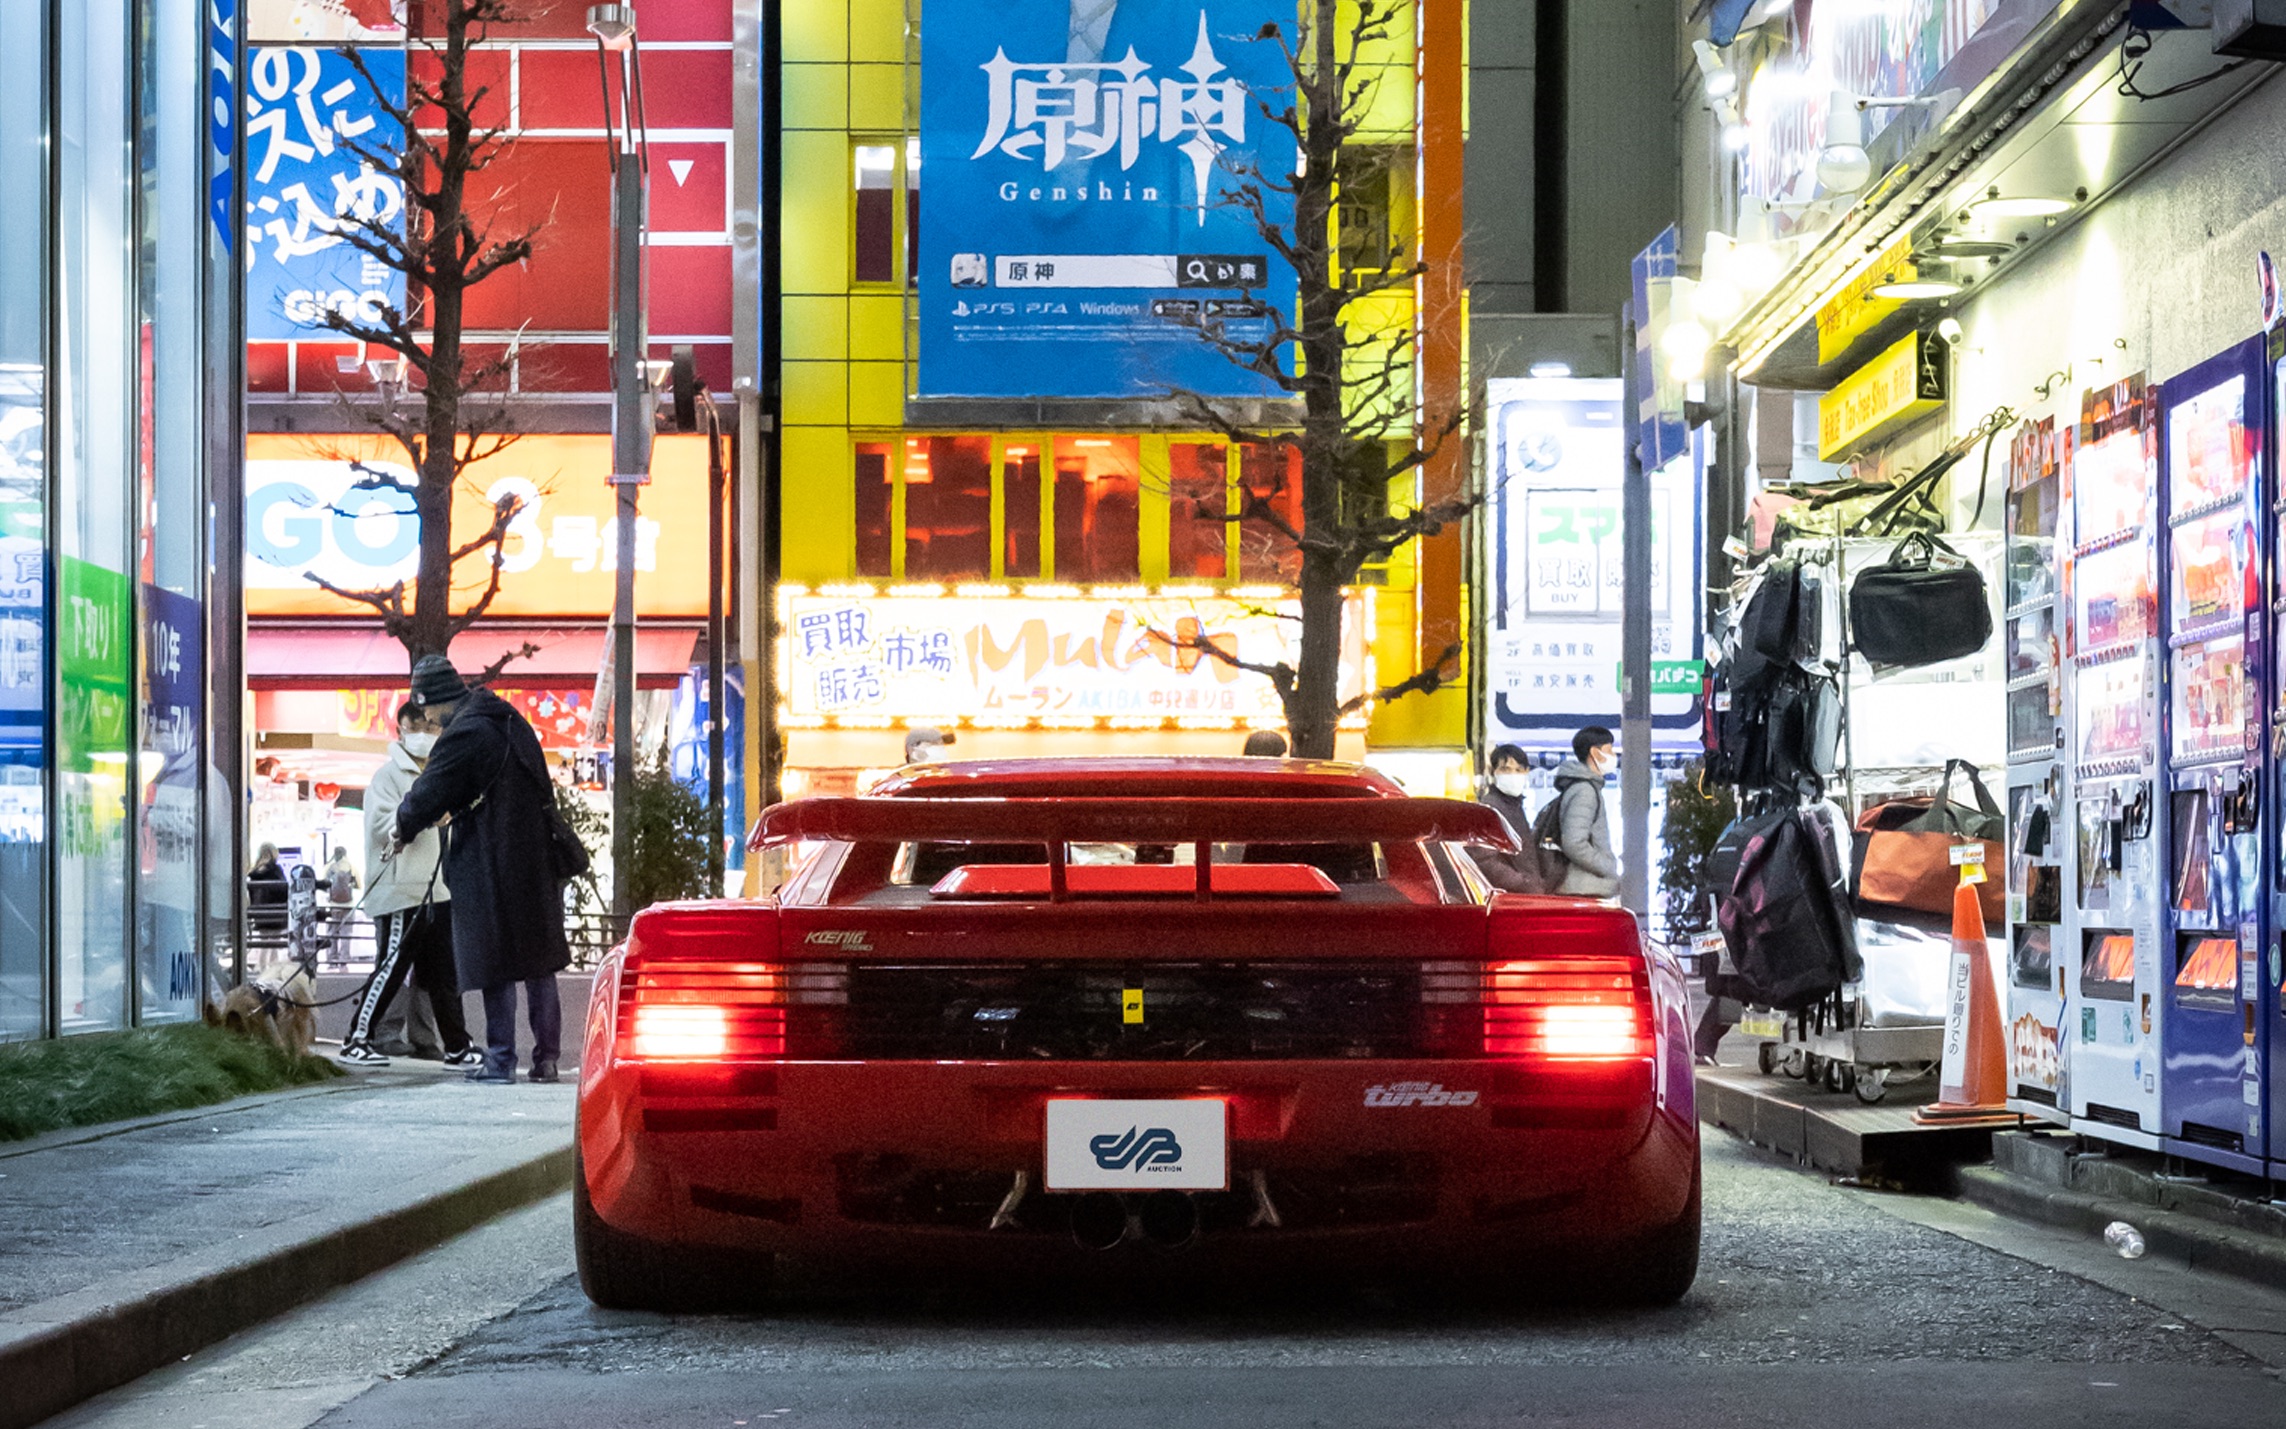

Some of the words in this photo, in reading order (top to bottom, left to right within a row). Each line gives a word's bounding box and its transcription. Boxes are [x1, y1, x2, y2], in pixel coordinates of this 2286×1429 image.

[970, 9, 1246, 228] 原神
[999, 182, 1159, 201] Genshin
[1008, 261, 1056, 281] 原神
[973, 302, 1015, 316] PS5
[1026, 302, 1068, 315] PS4
[1079, 302, 1139, 315] Windows
[801, 608, 869, 657] 買取
[152, 620, 181, 684] 10年
[886, 632, 952, 673] 市場
[819, 655, 880, 705] 販売
[983, 684, 1073, 710] ムーラン
[1363, 1084, 1479, 1107] turbo
